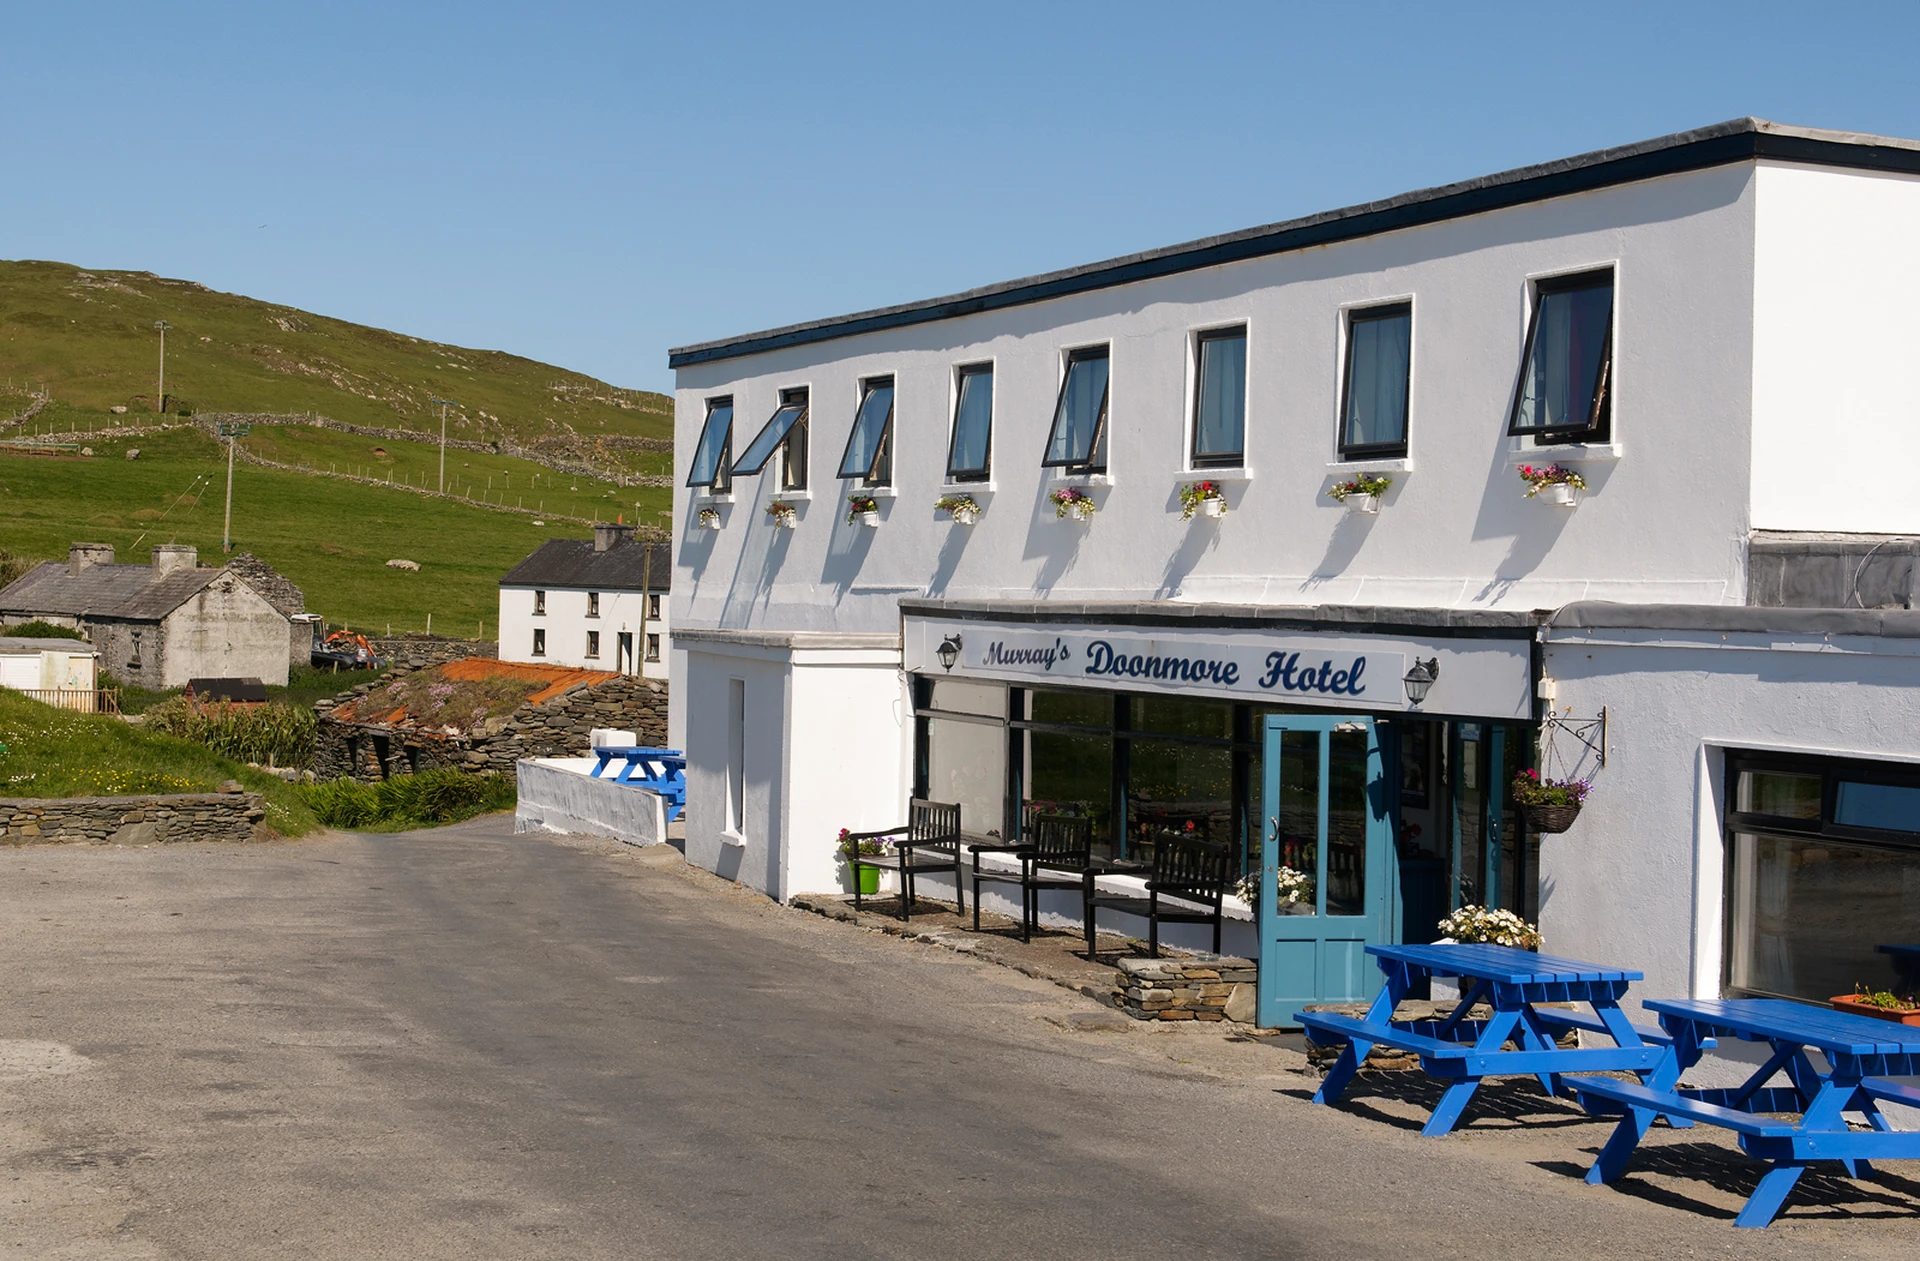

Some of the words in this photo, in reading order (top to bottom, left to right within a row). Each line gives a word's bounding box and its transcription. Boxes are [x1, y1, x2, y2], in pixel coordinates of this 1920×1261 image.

[983, 637, 1071, 671] Murray's
[1085, 640, 1240, 685] Doonmore
[1258, 650, 1366, 696] Hotel
